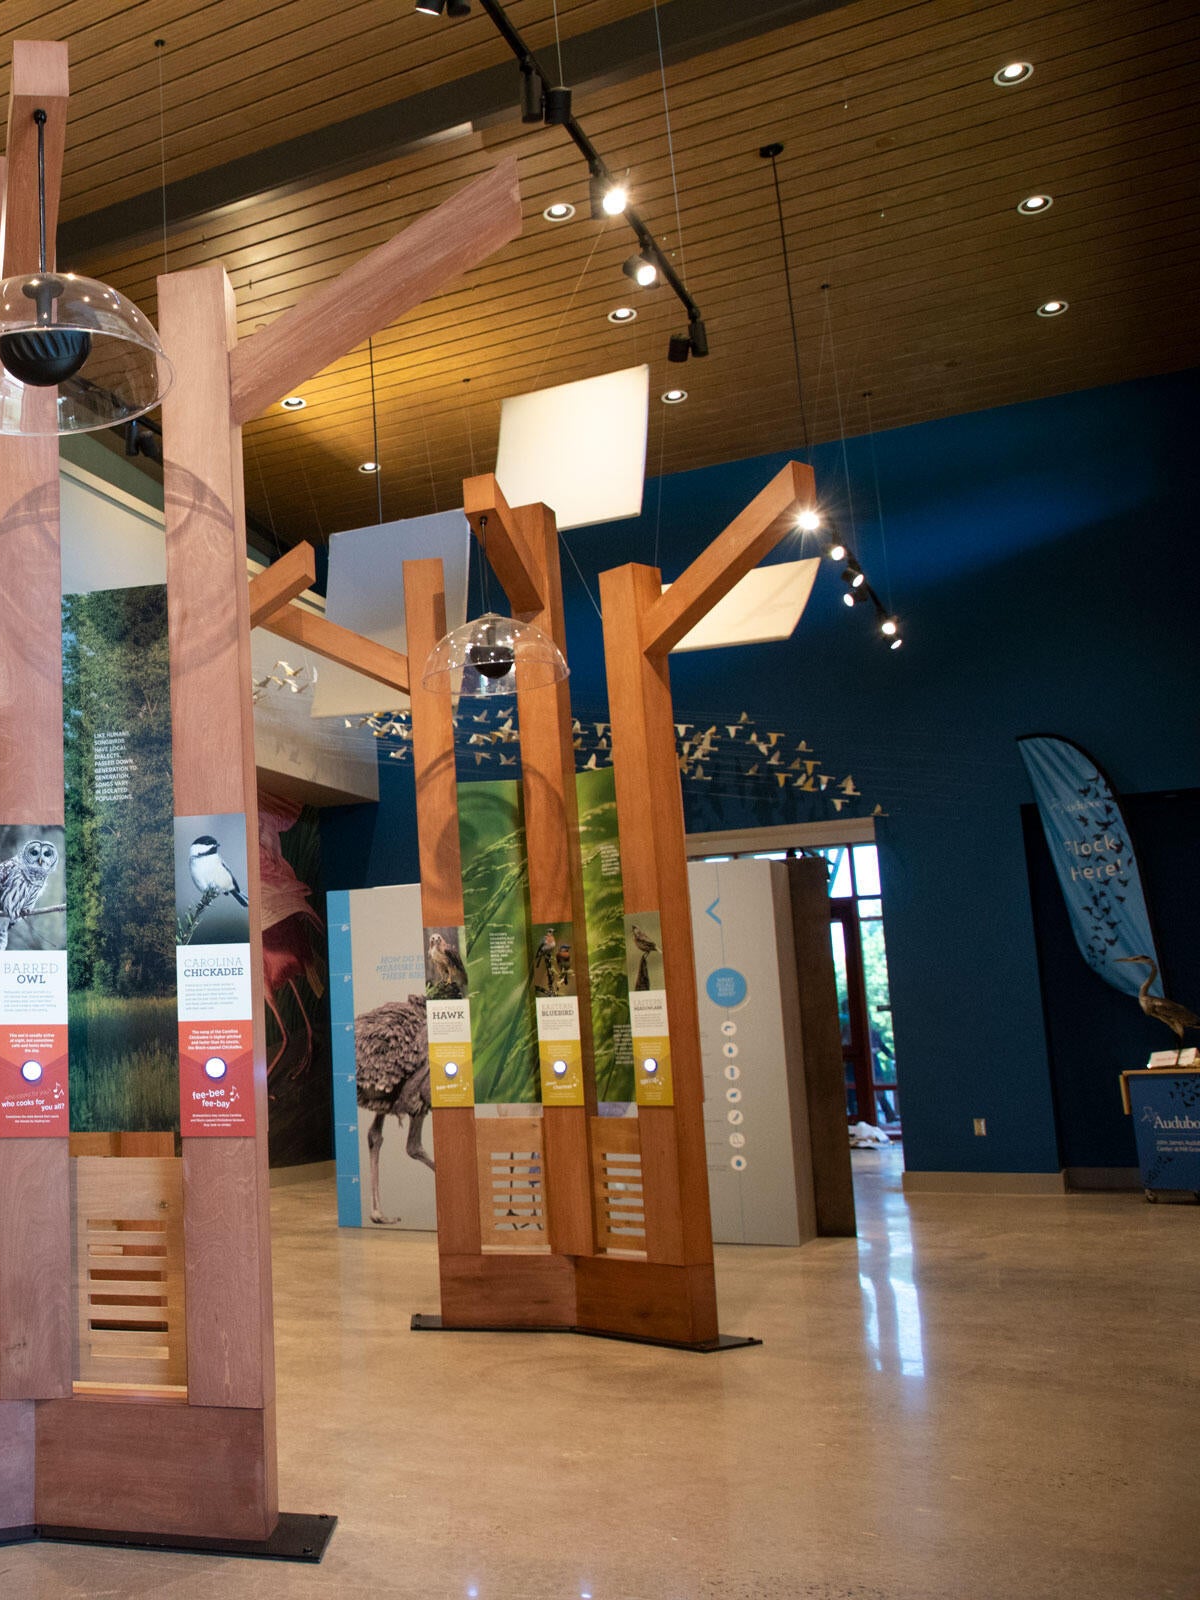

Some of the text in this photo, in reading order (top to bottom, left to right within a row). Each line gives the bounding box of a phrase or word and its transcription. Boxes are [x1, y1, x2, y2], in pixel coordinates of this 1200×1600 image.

[1071, 859, 1124, 881] Here!
[184, 957, 243, 968] CAROLINA
[3, 962, 60, 974] BARRED
[184, 967, 244, 977] CHICKADEE
[17, 974, 46, 984] OWL
[432, 1011, 465, 1021] HAWK
[192, 1089, 225, 1100] fee-bee
[41, 1104, 53, 1112] you
[202, 1100, 230, 1109] fee-bay
[1153, 1115, 1200, 1129] Audubo
